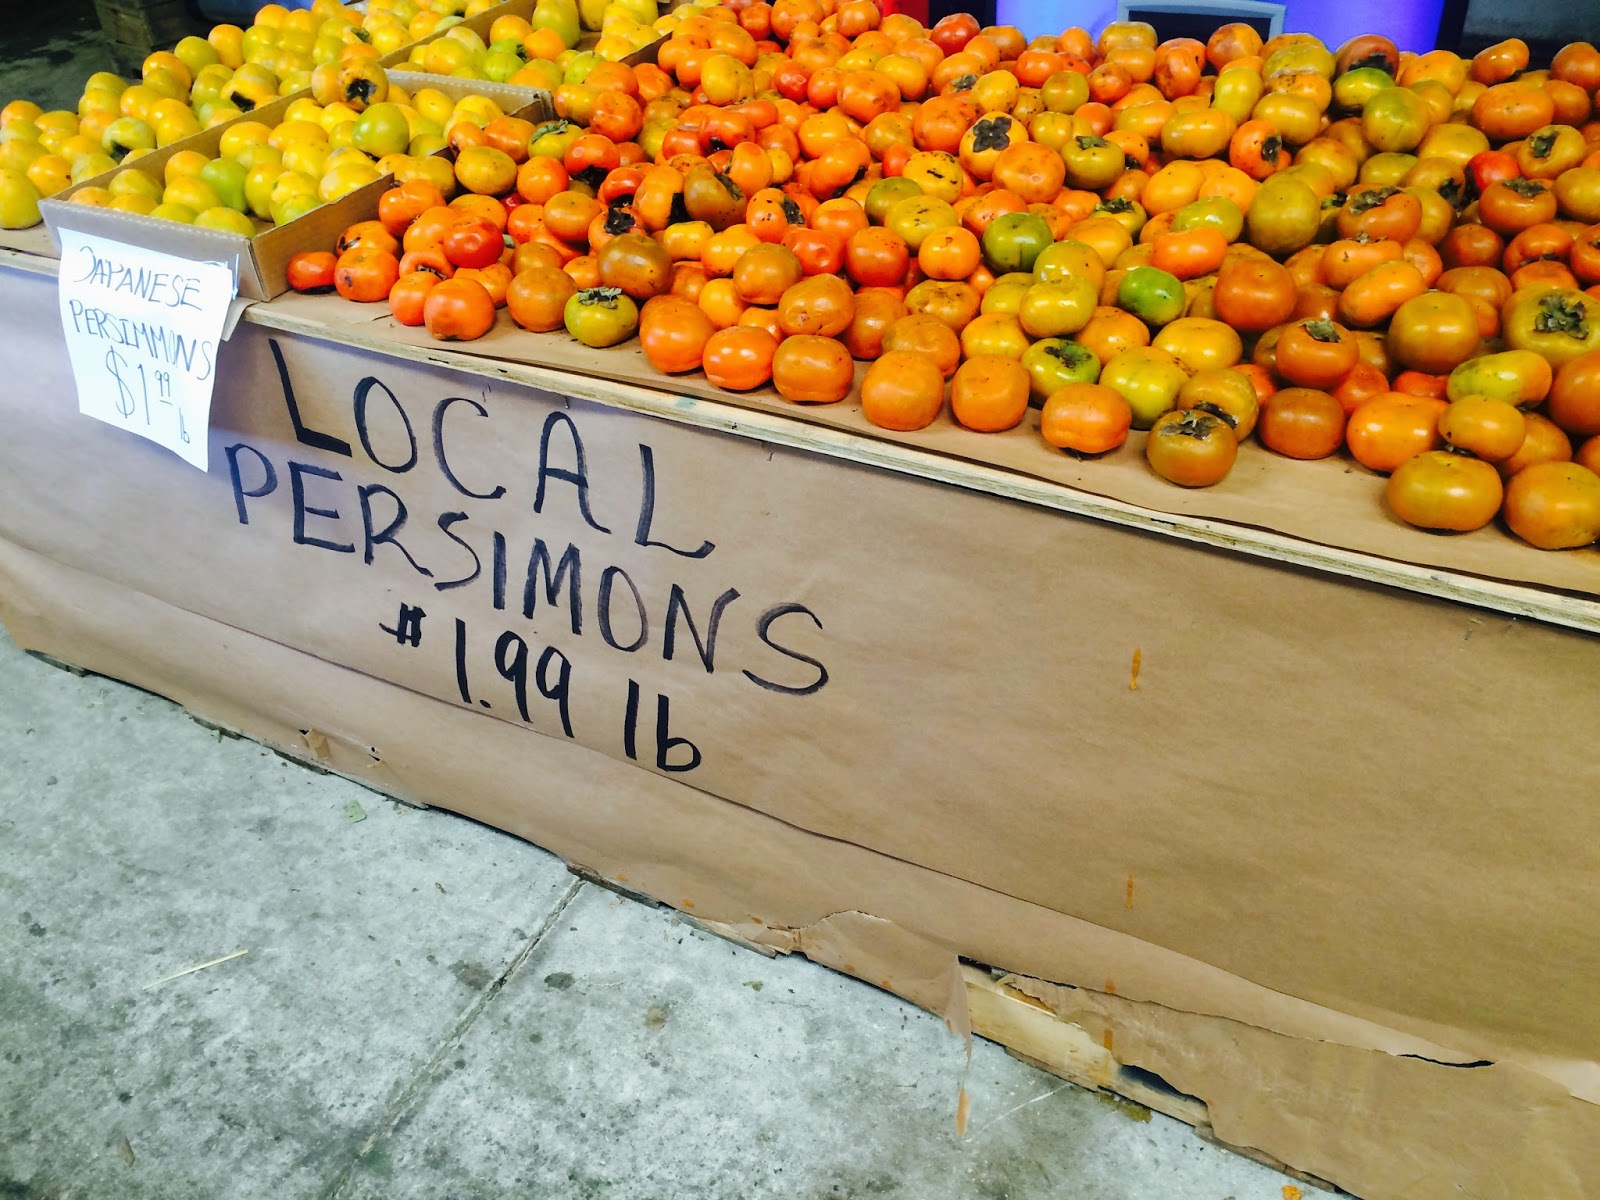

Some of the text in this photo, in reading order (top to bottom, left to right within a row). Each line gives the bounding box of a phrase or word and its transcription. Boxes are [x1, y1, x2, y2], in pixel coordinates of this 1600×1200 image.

[73, 245, 202, 311] JAPANESE
[69, 299, 213, 380] PERSIMMONS
[268, 338, 716, 559] LOCAL
[224, 442, 830, 696] PERSIMONS
[623, 678, 702, 773] lb
